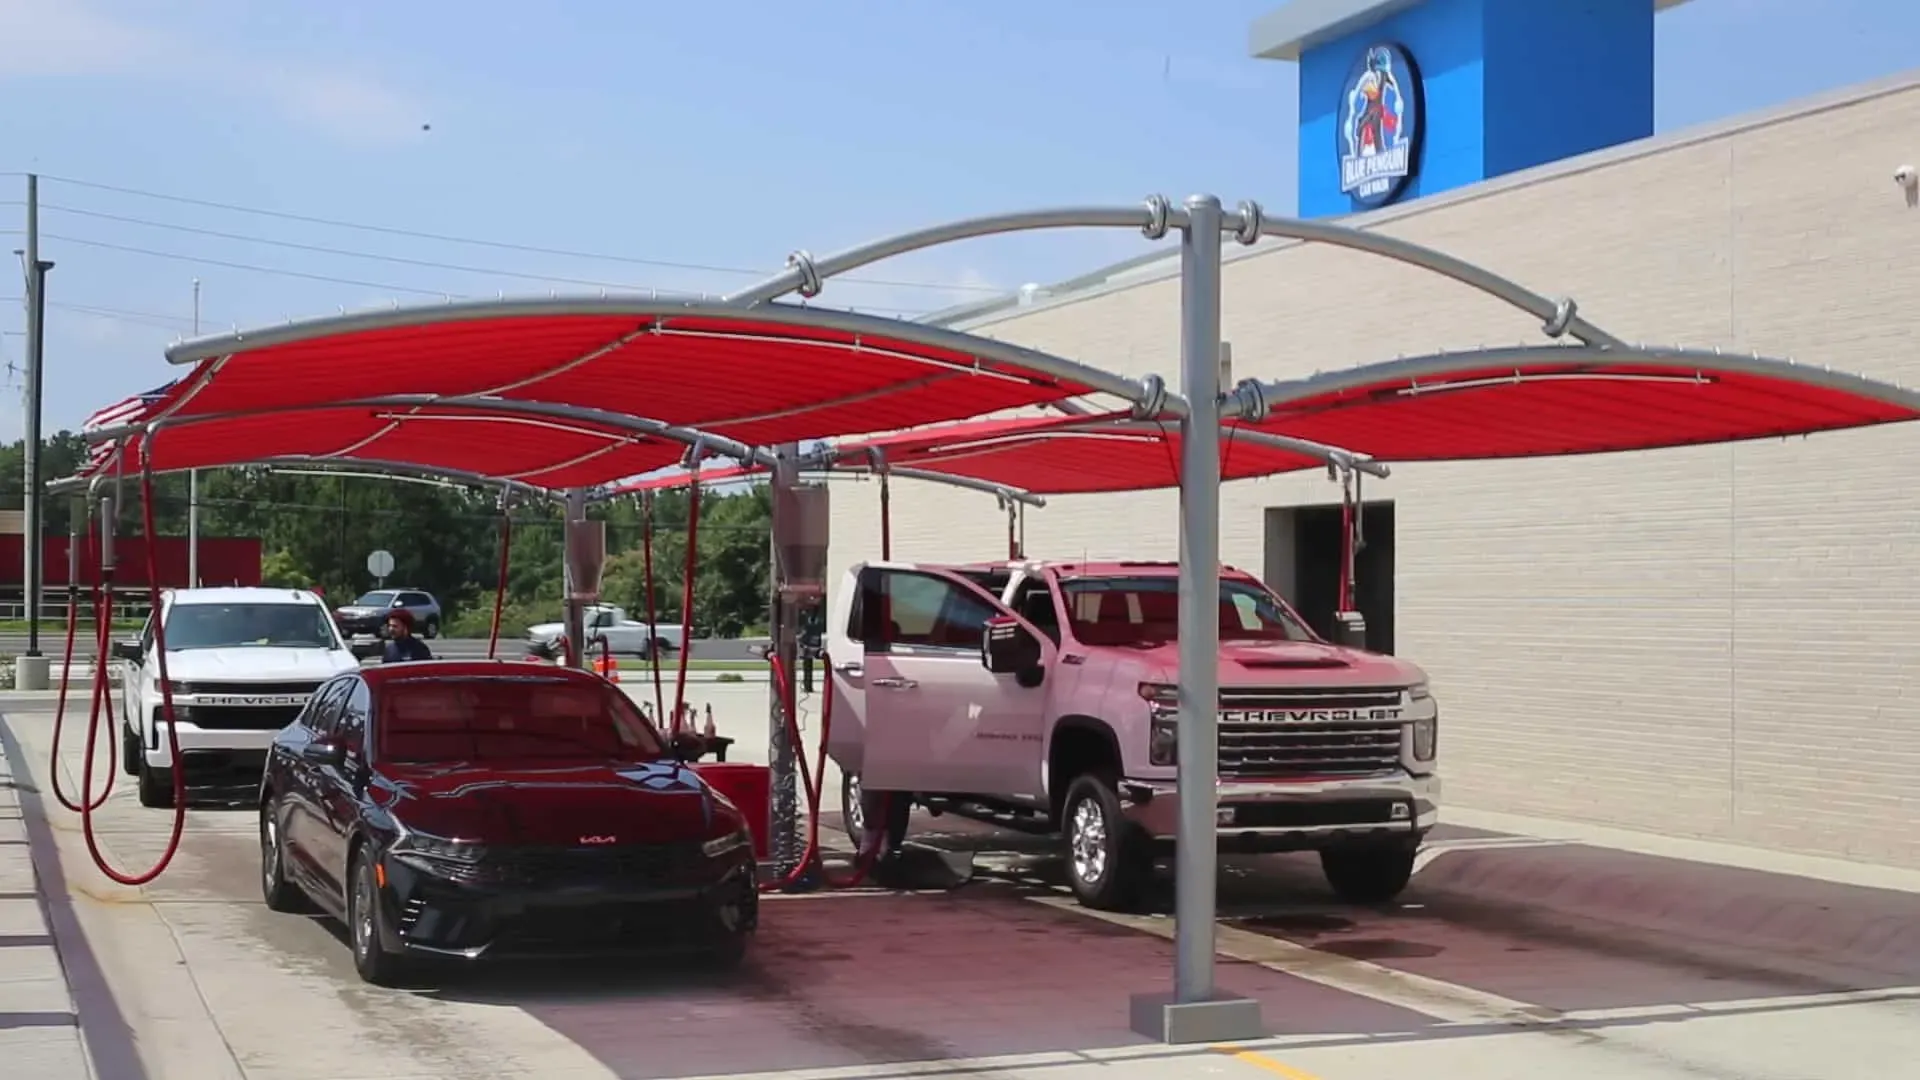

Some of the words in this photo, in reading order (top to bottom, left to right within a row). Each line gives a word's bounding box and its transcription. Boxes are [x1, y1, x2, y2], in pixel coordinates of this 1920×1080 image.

[1345, 158, 1367, 185] BLUE
[1366, 147, 1405, 176] PENGUIN
[1359, 182, 1371, 198] CAR
[1222, 708, 1404, 722] CHEVROLET
